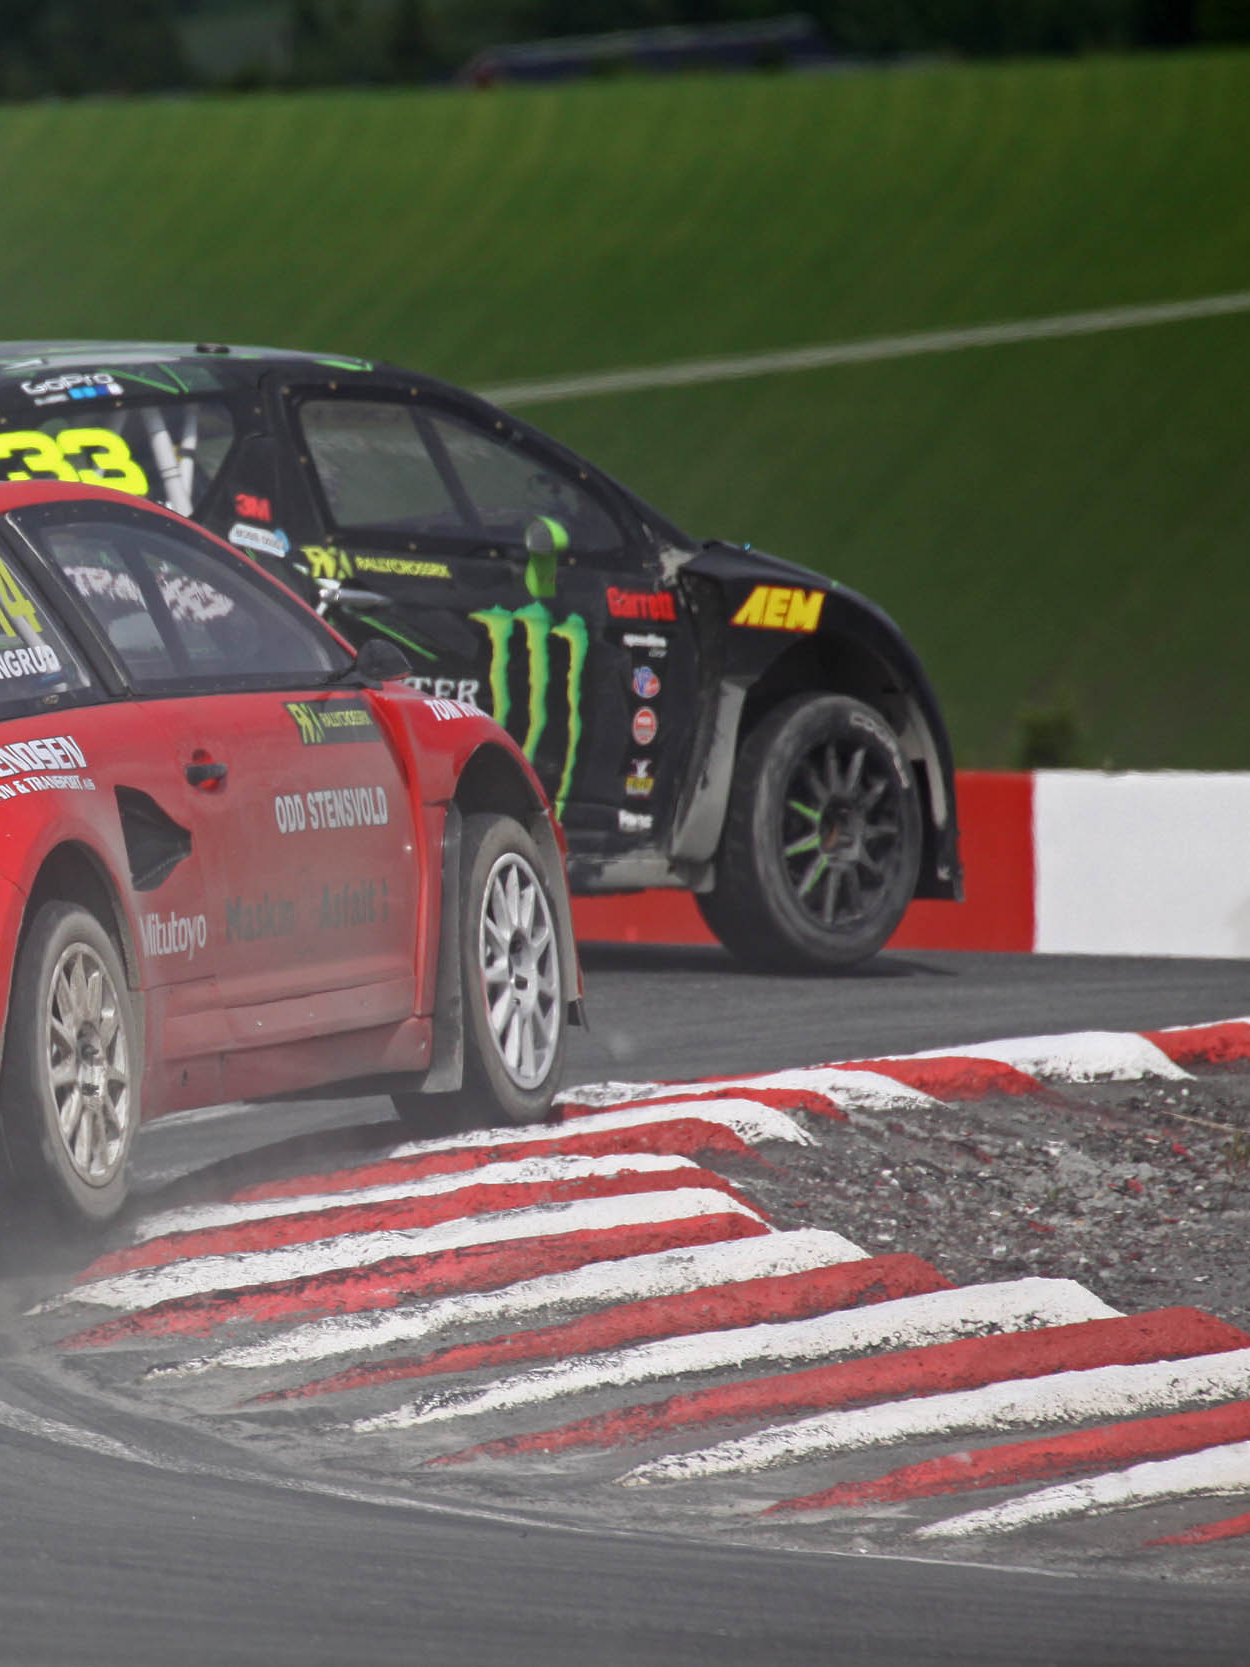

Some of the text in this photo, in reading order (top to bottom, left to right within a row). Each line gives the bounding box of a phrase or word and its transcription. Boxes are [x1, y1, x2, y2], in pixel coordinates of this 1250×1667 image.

[21, 373, 114, 395] GoPro
[235, 493, 271, 521] 3M
[730, 585, 826, 633] AEM
[12, 780, 31, 794] &
[23, 775, 84, 791] TRANSPORT
[275, 786, 388, 834] ODD STENSVOLD
[138, 911, 206, 961] Mitutoyo
